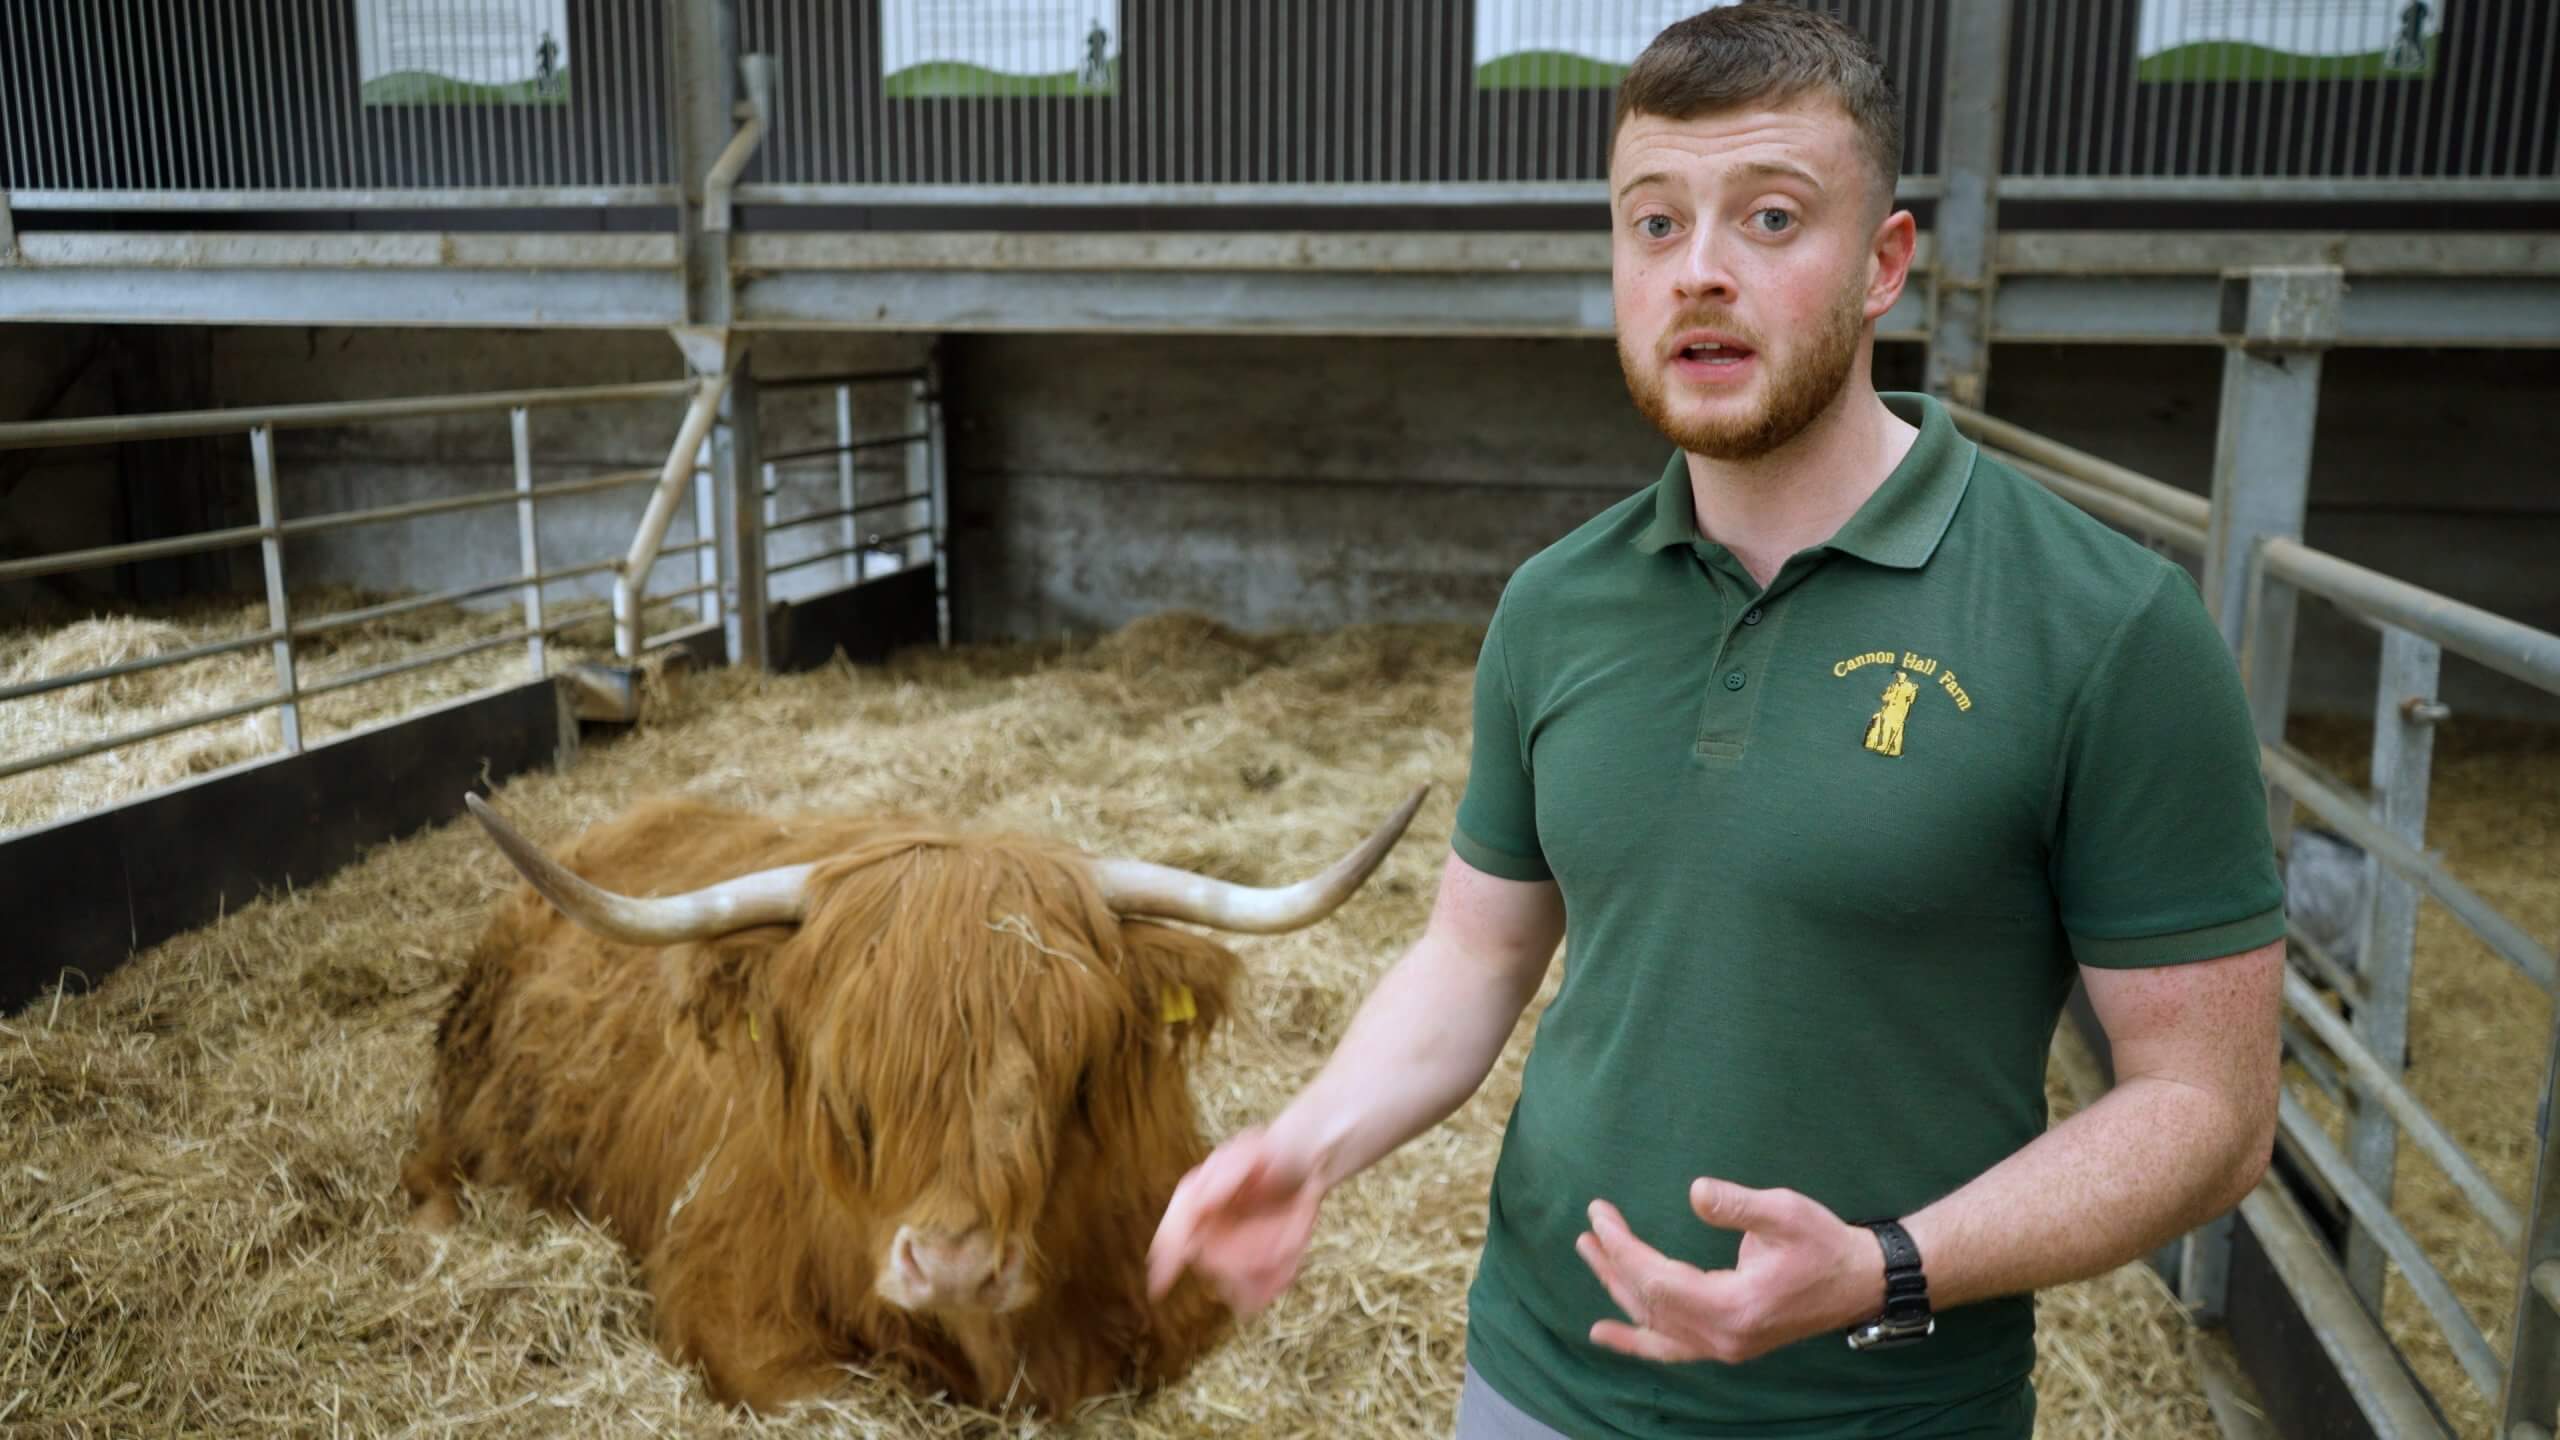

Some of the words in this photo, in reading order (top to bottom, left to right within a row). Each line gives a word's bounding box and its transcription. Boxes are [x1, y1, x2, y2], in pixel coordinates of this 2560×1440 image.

[1833, 651, 1895, 677] Cannon
[1902, 652, 1937, 675] Hall
[1938, 670, 1973, 712] Farm
